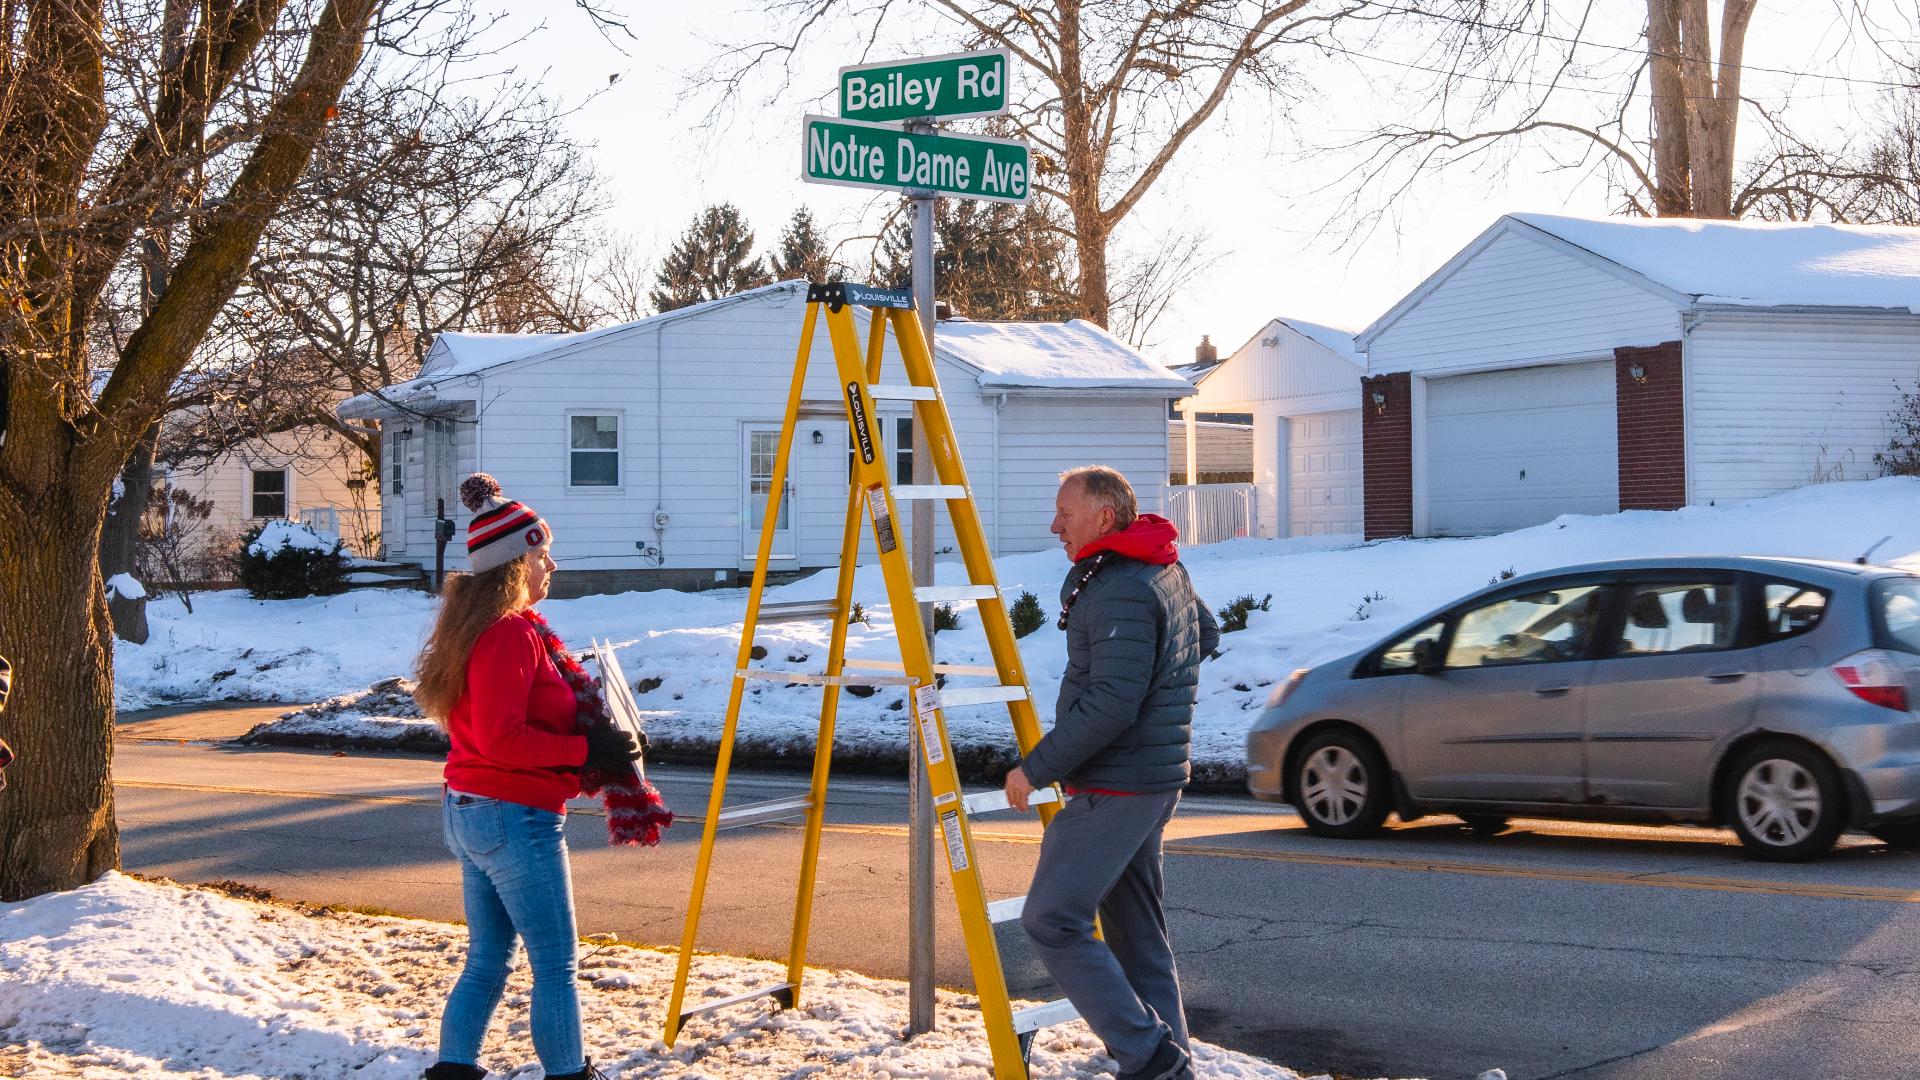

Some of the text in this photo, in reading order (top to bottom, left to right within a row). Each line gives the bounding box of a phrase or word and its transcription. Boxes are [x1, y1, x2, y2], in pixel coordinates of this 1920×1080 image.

[846, 61, 1001, 111] Bailey Rd
[810, 127, 1025, 196] Notre Dame Ave
[860, 292, 908, 303] LOUISVILLE
[851, 393, 872, 463] LOUISVILLE
